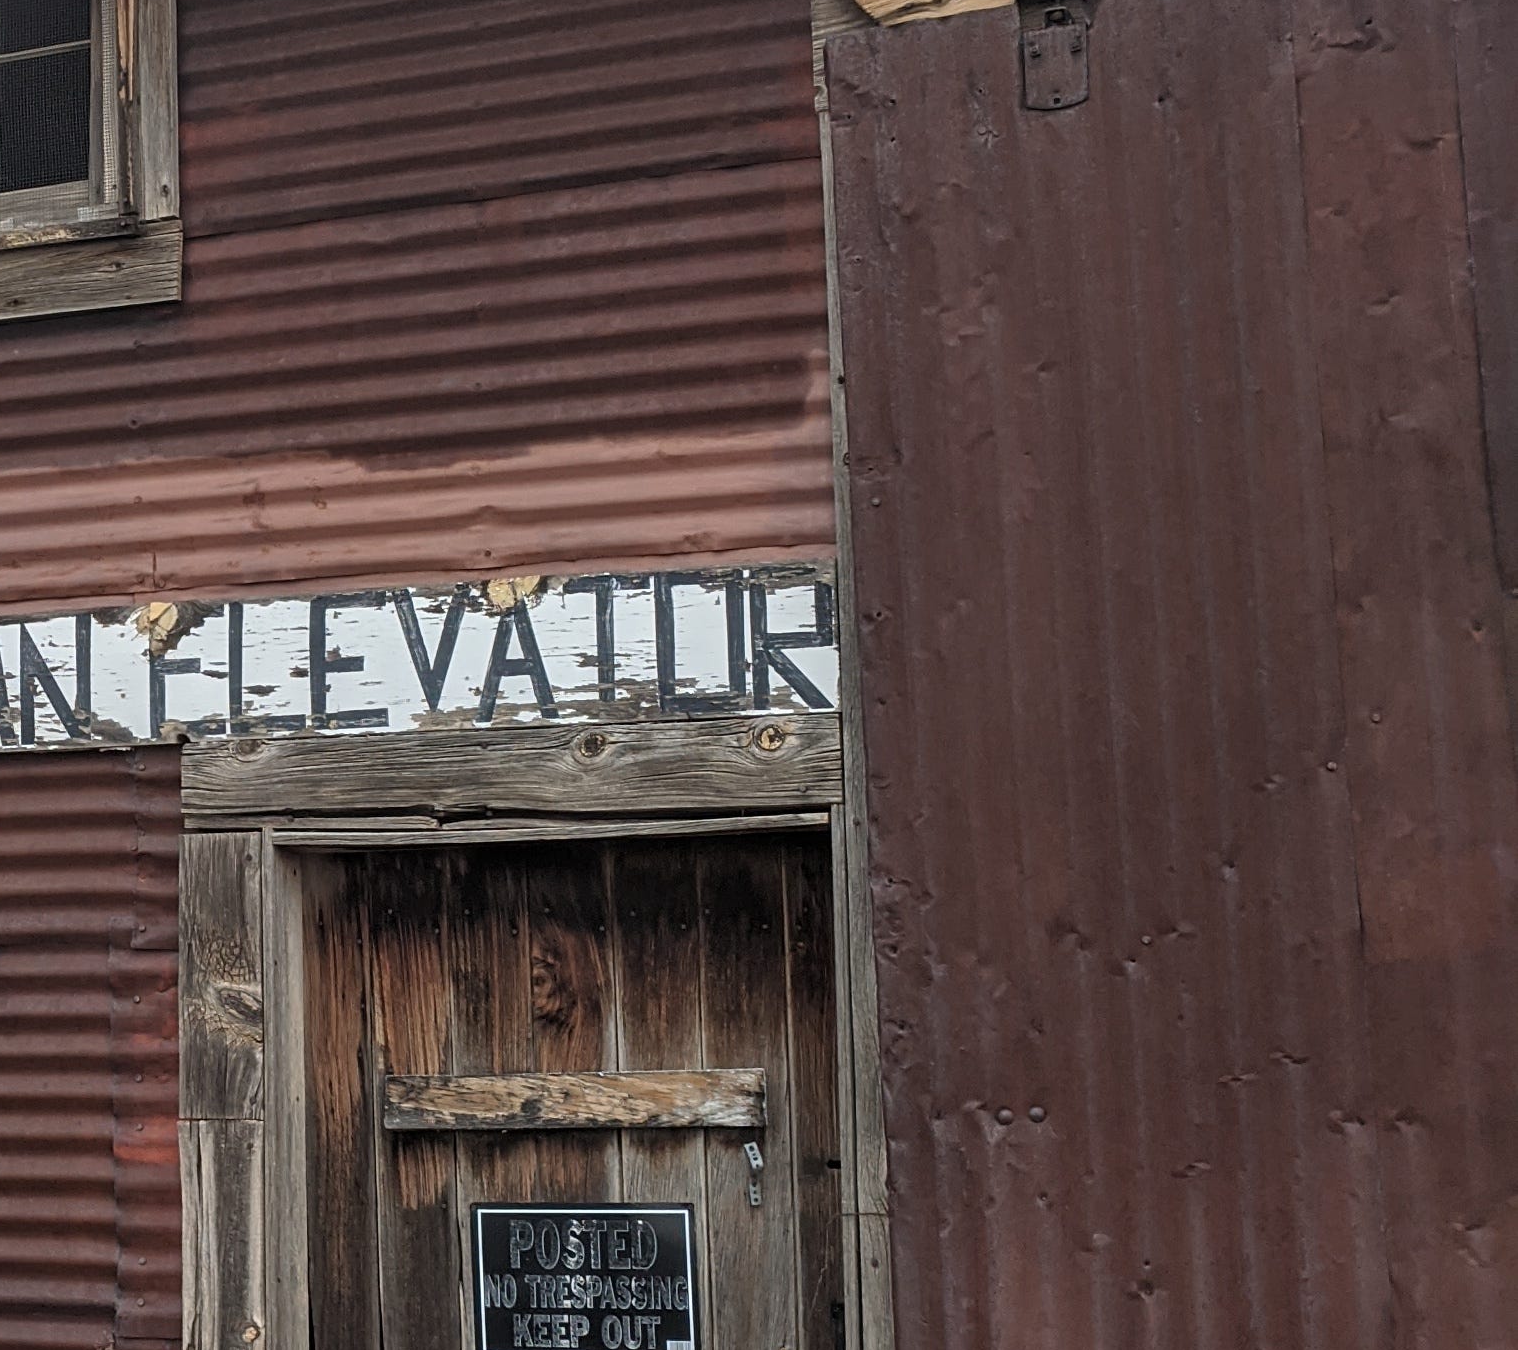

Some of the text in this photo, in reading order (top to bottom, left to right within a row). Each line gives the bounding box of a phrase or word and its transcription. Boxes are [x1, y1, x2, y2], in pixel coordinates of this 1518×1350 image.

[148, 565, 836, 741] ELEVATOR
[509, 1218, 658, 1270] POSTED
[484, 1273, 690, 1311] NO TRESPASSING
[513, 1313, 661, 1350] KEEP OUT
